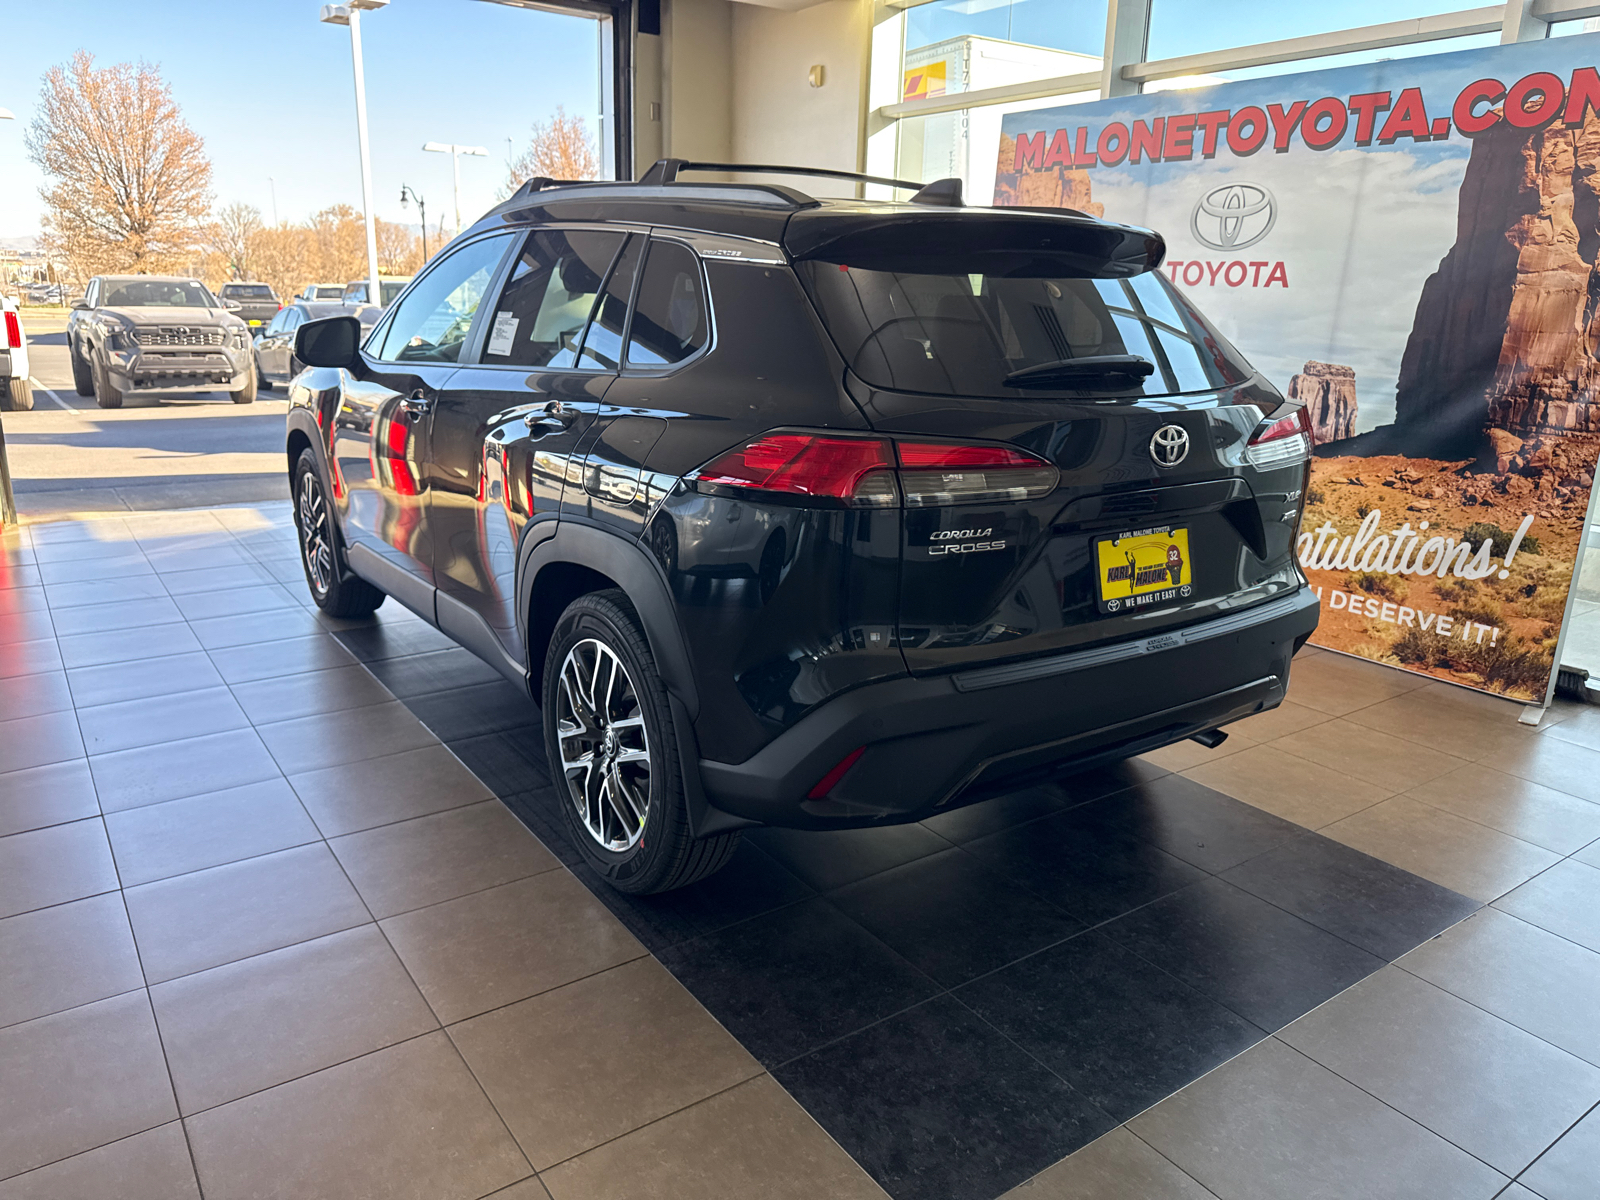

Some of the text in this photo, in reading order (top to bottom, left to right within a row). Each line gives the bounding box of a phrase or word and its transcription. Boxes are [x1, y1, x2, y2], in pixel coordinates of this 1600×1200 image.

[1013, 66, 1600, 173] MALONETOYOTA.COM
[1166, 260, 1289, 288] TOYOTA
[929, 527, 993, 540] COROLLA
[1133, 529, 1152, 537] MALONE
[1153, 526, 1170, 534] TOYOTA
[928, 540, 1006, 555] CROSS
[1169, 550, 1178, 561] 32
[1107, 565, 1131, 583] KARL
[1135, 568, 1167, 587] MALONE
[1125, 589, 1176, 608] WE MAKE IT EASY
[1329, 589, 1454, 636] DESERVE
[1462, 620, 1499, 648] IT!
